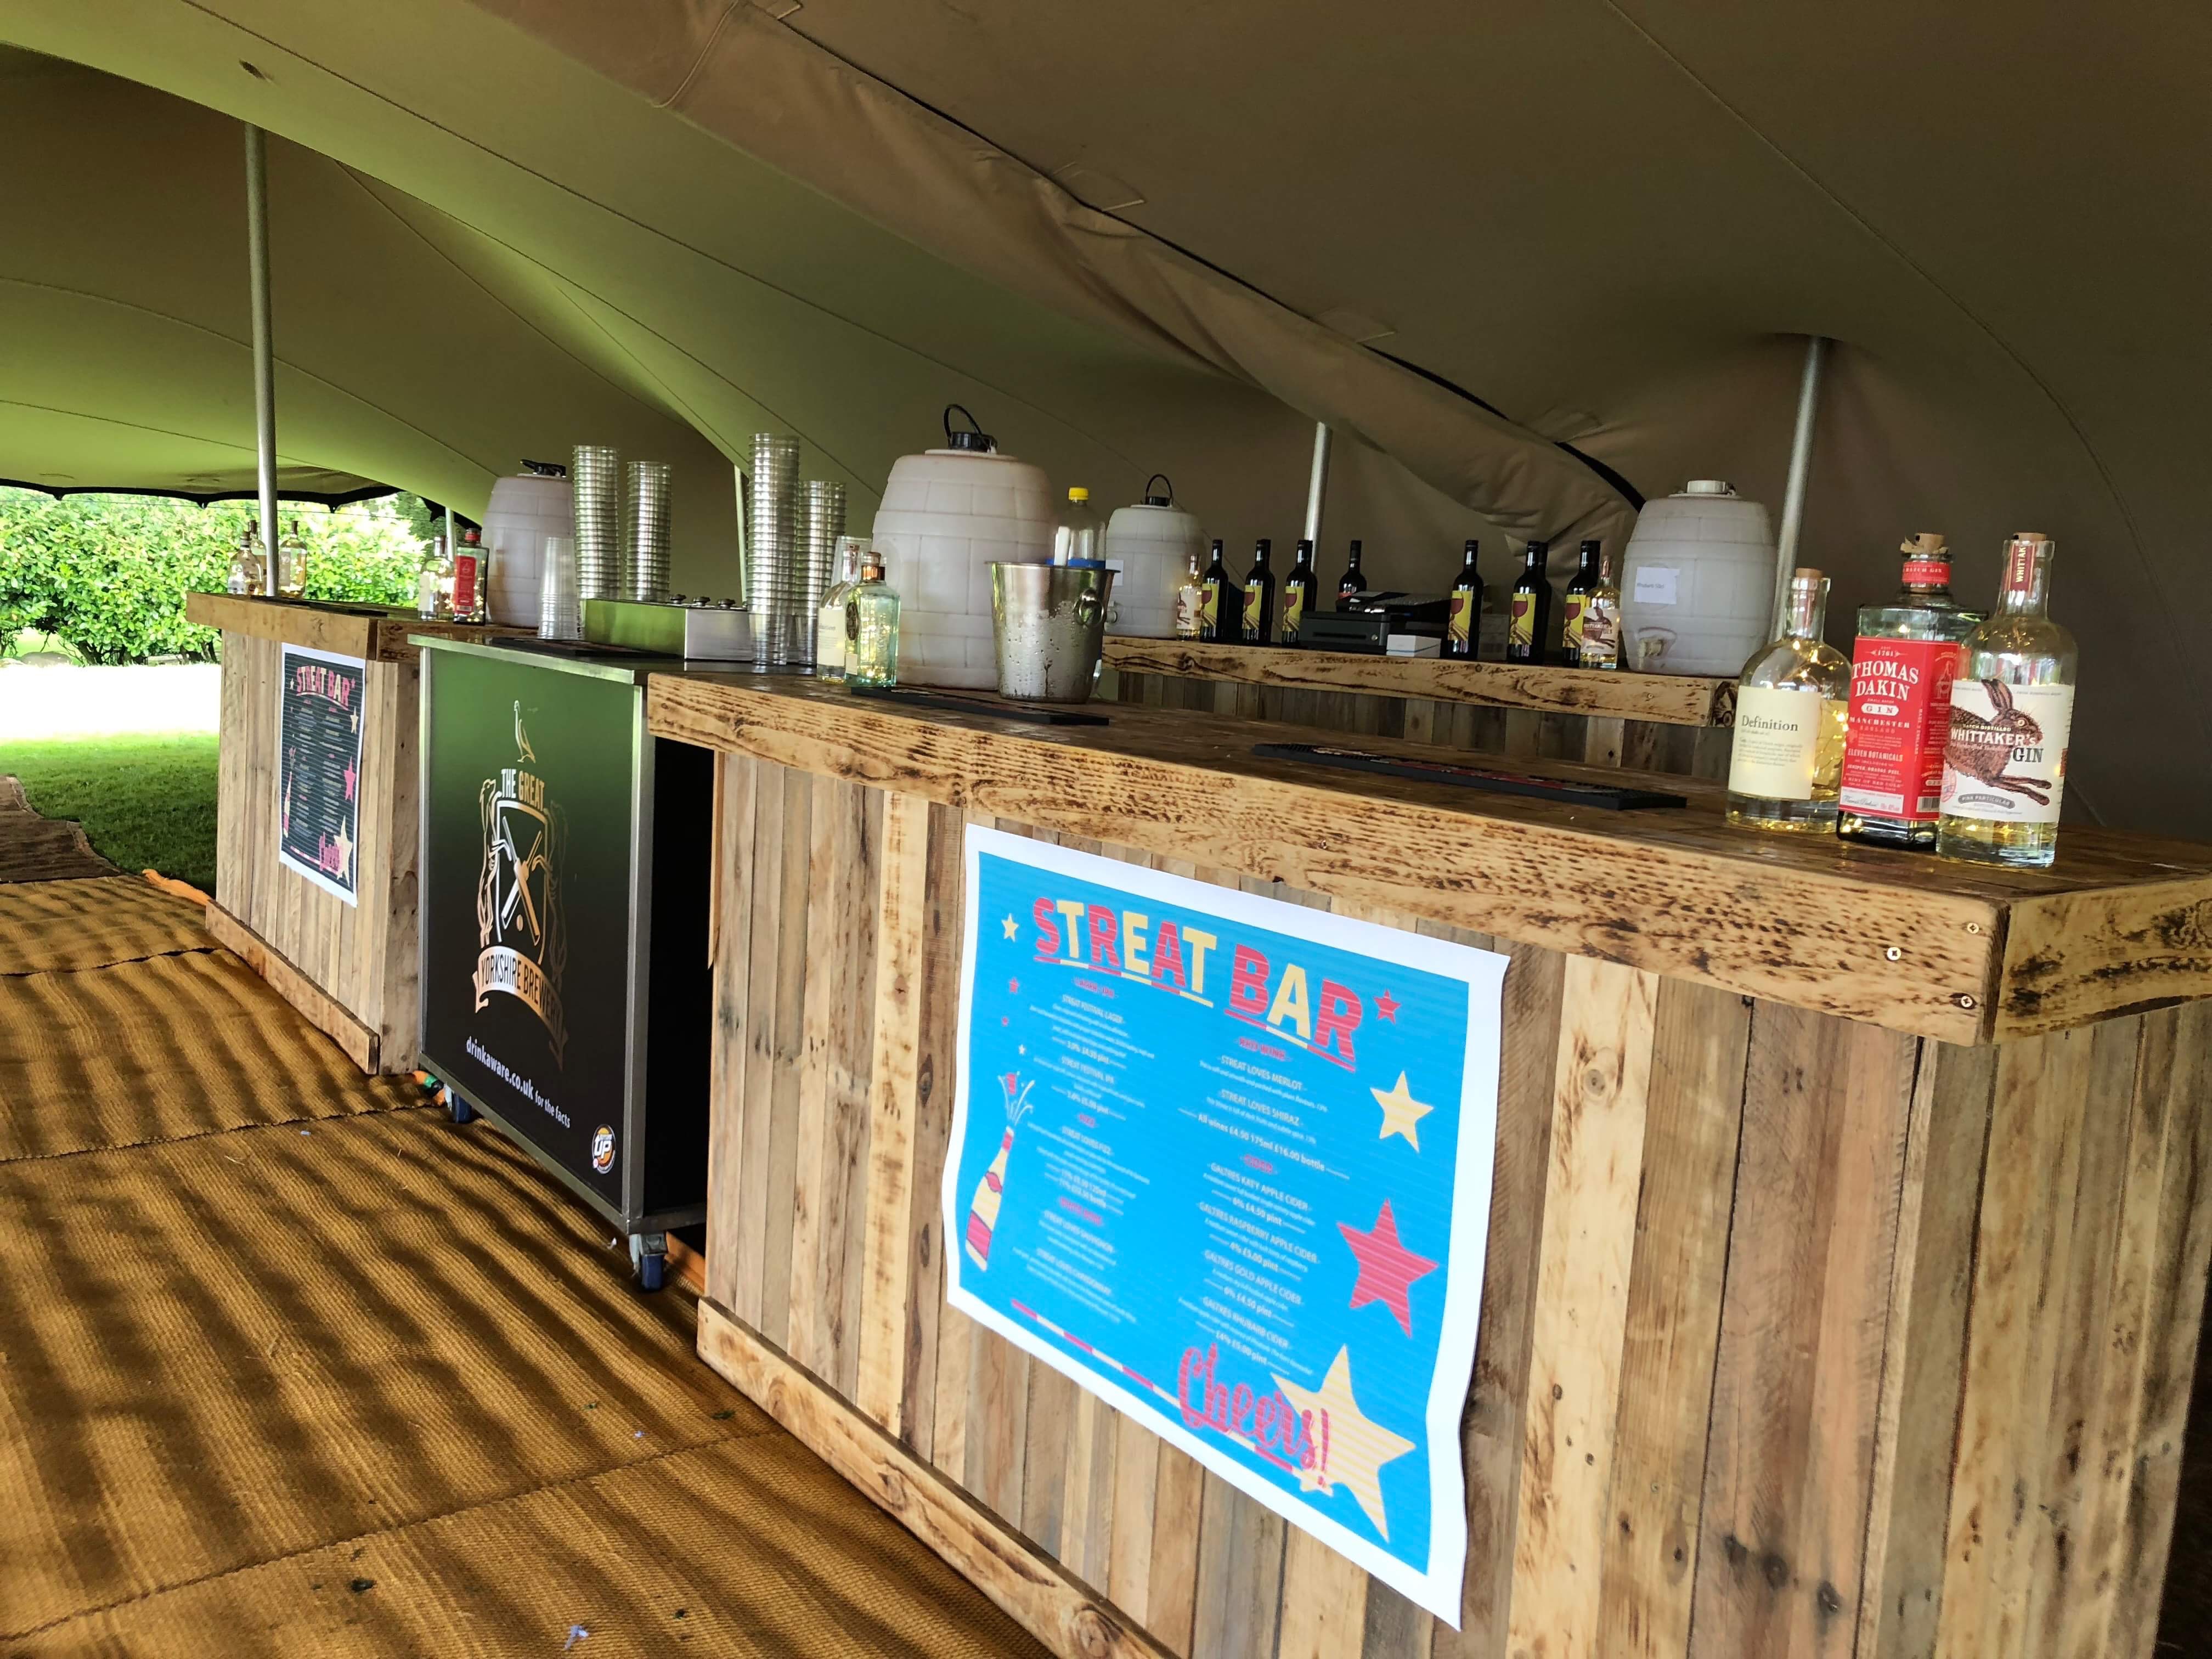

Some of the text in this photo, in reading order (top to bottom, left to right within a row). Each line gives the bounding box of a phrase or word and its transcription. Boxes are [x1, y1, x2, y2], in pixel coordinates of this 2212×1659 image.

[297, 665, 350, 707] STREAT BAR
[1852, 660, 1919, 685] THOMAS
[1855, 679, 1910, 701] DAKIN
[1850, 716, 1910, 729] MANCHESTER
[1866, 705, 1893, 713] GIN
[1742, 715, 1799, 732] Definition
[1848, 748, 1904, 763] ELEVEN BOTANICALS
[2013, 747, 2044, 763] GIN
[501, 768, 545, 812] THE GREAT
[481, 953, 522, 990] YORKSHIRE
[1033, 896, 1217, 995] STREAT
[1229, 944, 1363, 1063] BAR
[1260, 1043, 1286, 1062] WINE
[466, 1035, 571, 1128] drinkaware.co.uk for the facts
[1221, 1054, 1303, 1091] STREAT LOVES MERLOT
[1221, 1089, 1300, 1127] STREAT LOVES SHIRAZ
[1198, 1113, 1207, 1124] All
[1301, 1154, 1325, 1172] bottle
[1261, 1184, 1285, 1201] APPLE
[1285, 1193, 1309, 1211] CIDER
[1266, 1213, 1283, 1226] pint
[1270, 1234, 1293, 1252] APPLE
[1294, 1245, 1318, 1263] CIDER
[1255, 1275, 1279, 1294] APPLE
[1177, 1342, 1331, 1488] Cheers!
